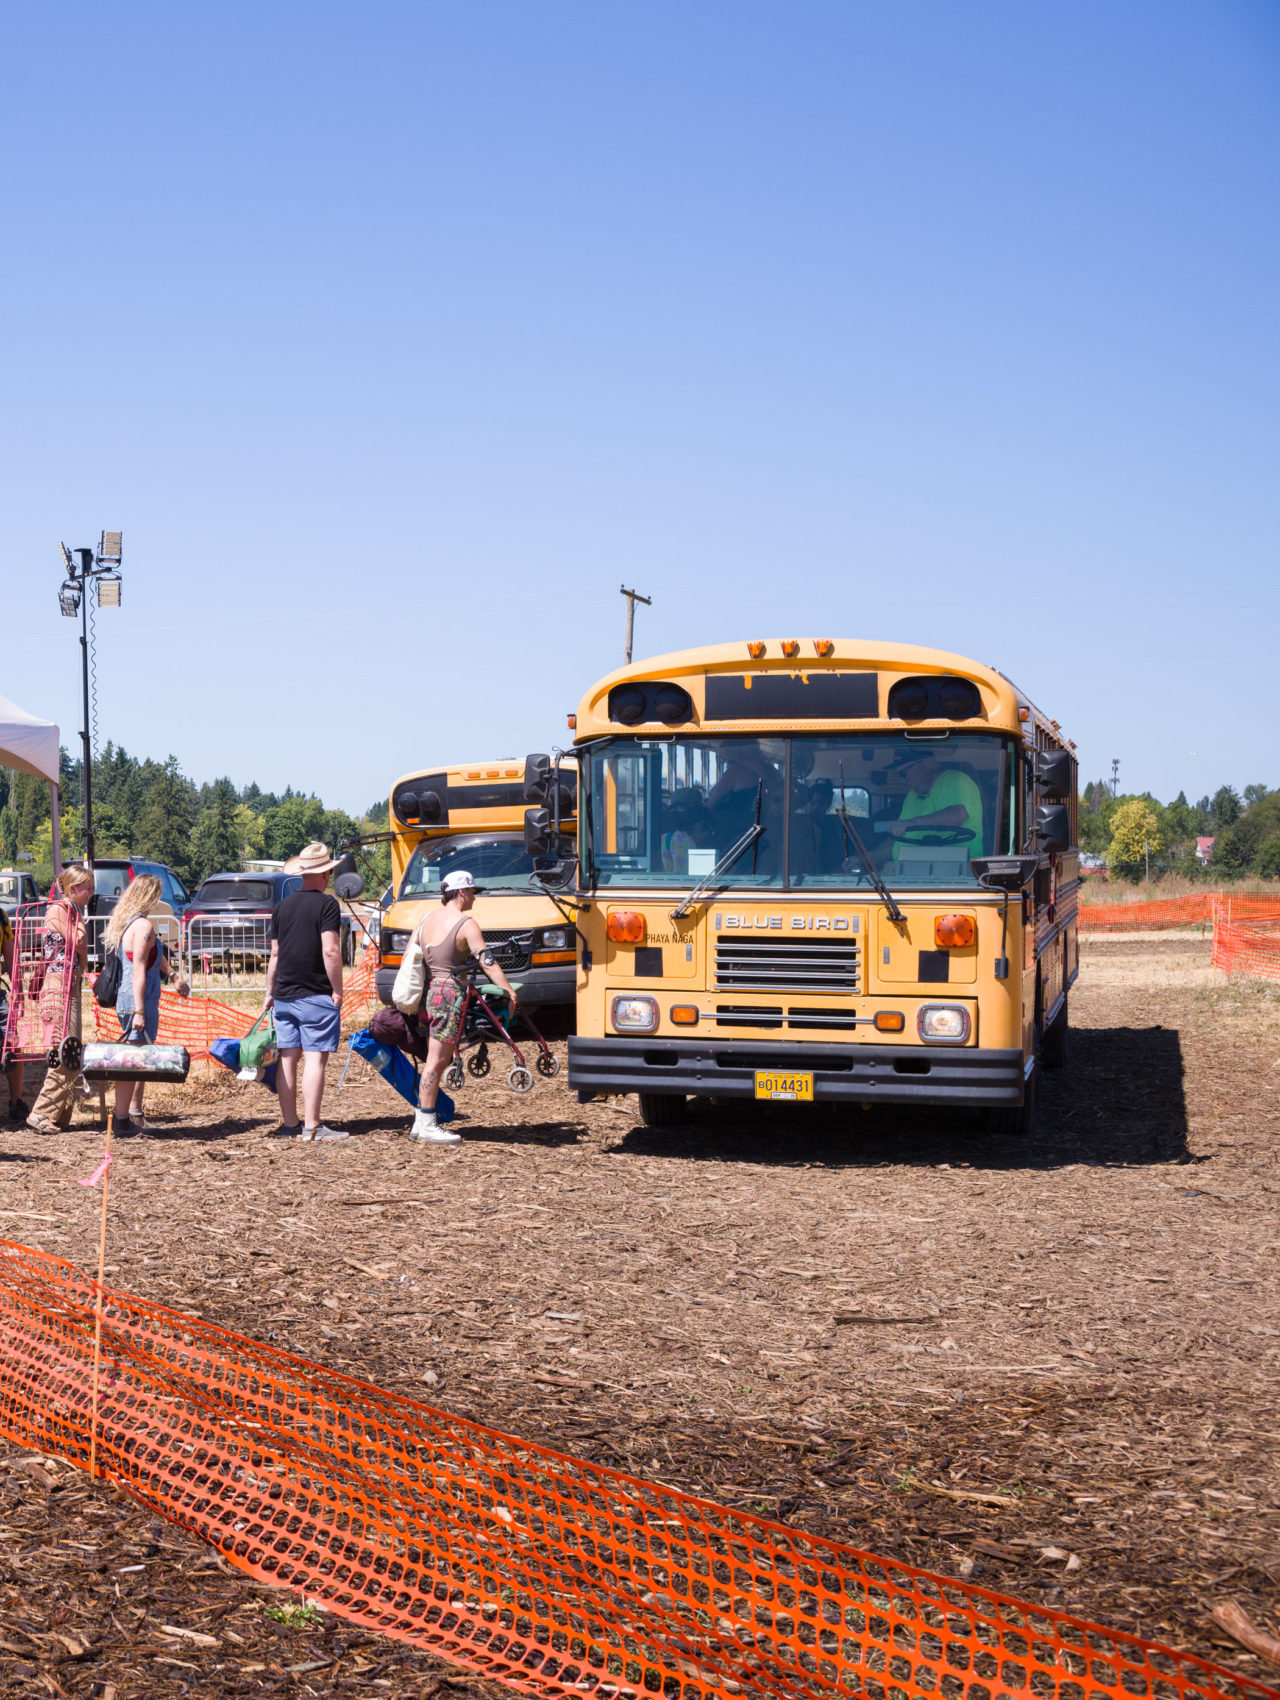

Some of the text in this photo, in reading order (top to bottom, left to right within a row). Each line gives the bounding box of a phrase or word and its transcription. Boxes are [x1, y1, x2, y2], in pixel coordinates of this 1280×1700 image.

[725, 915, 849, 930] BLUE BIRD
[645, 933, 694, 944] PHAYA NAGA
